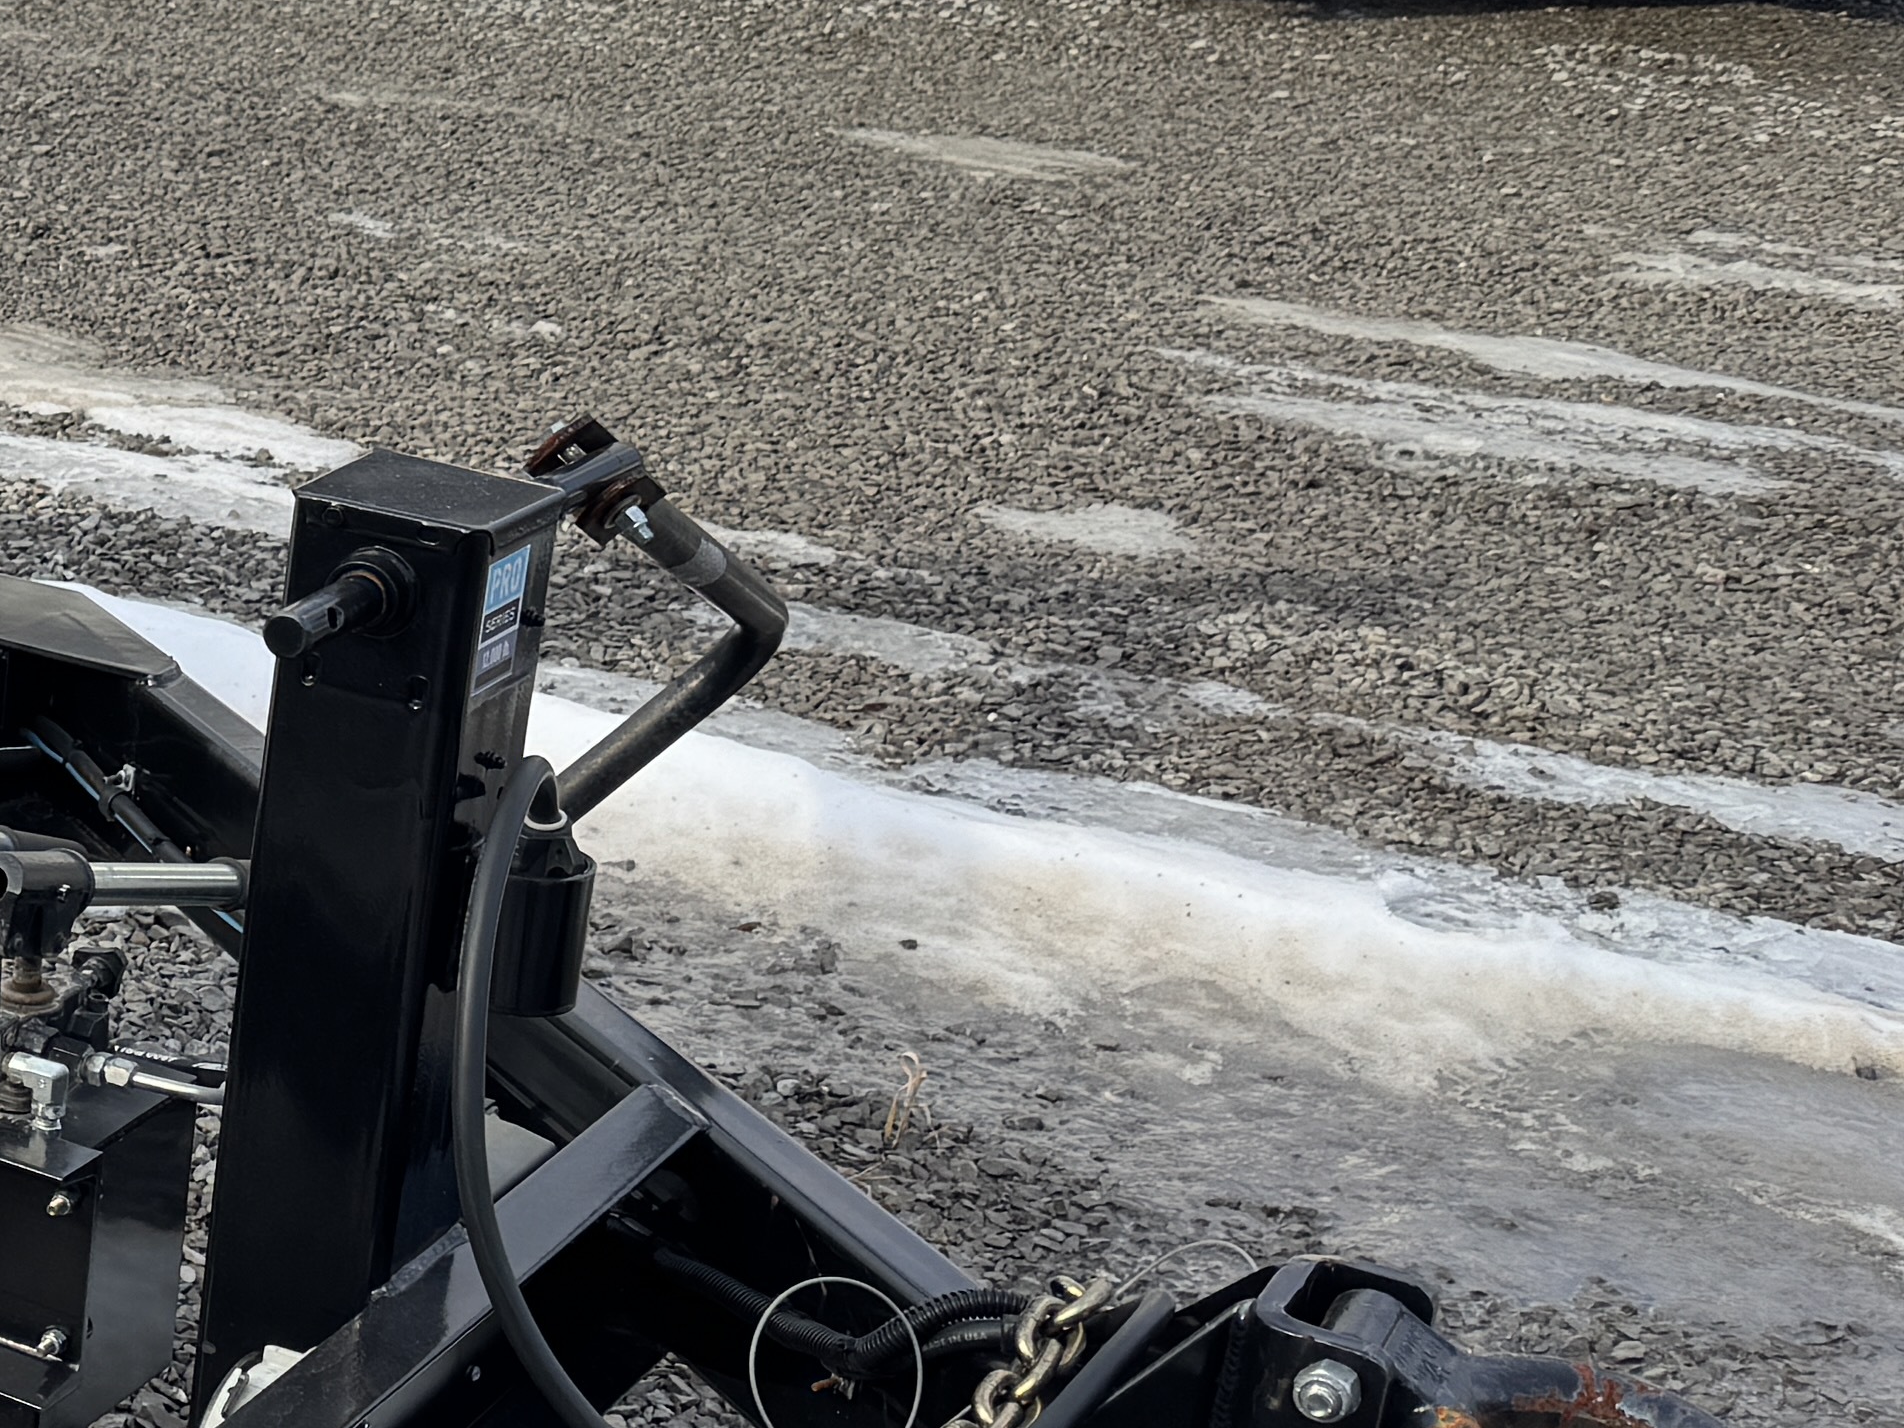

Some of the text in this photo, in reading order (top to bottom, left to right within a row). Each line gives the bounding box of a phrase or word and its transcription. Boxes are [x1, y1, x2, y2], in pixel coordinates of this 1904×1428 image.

[490, 556, 522, 605] PRO
[484, 606, 516, 634] SERIES
[964, 1331, 988, 1342] USA
